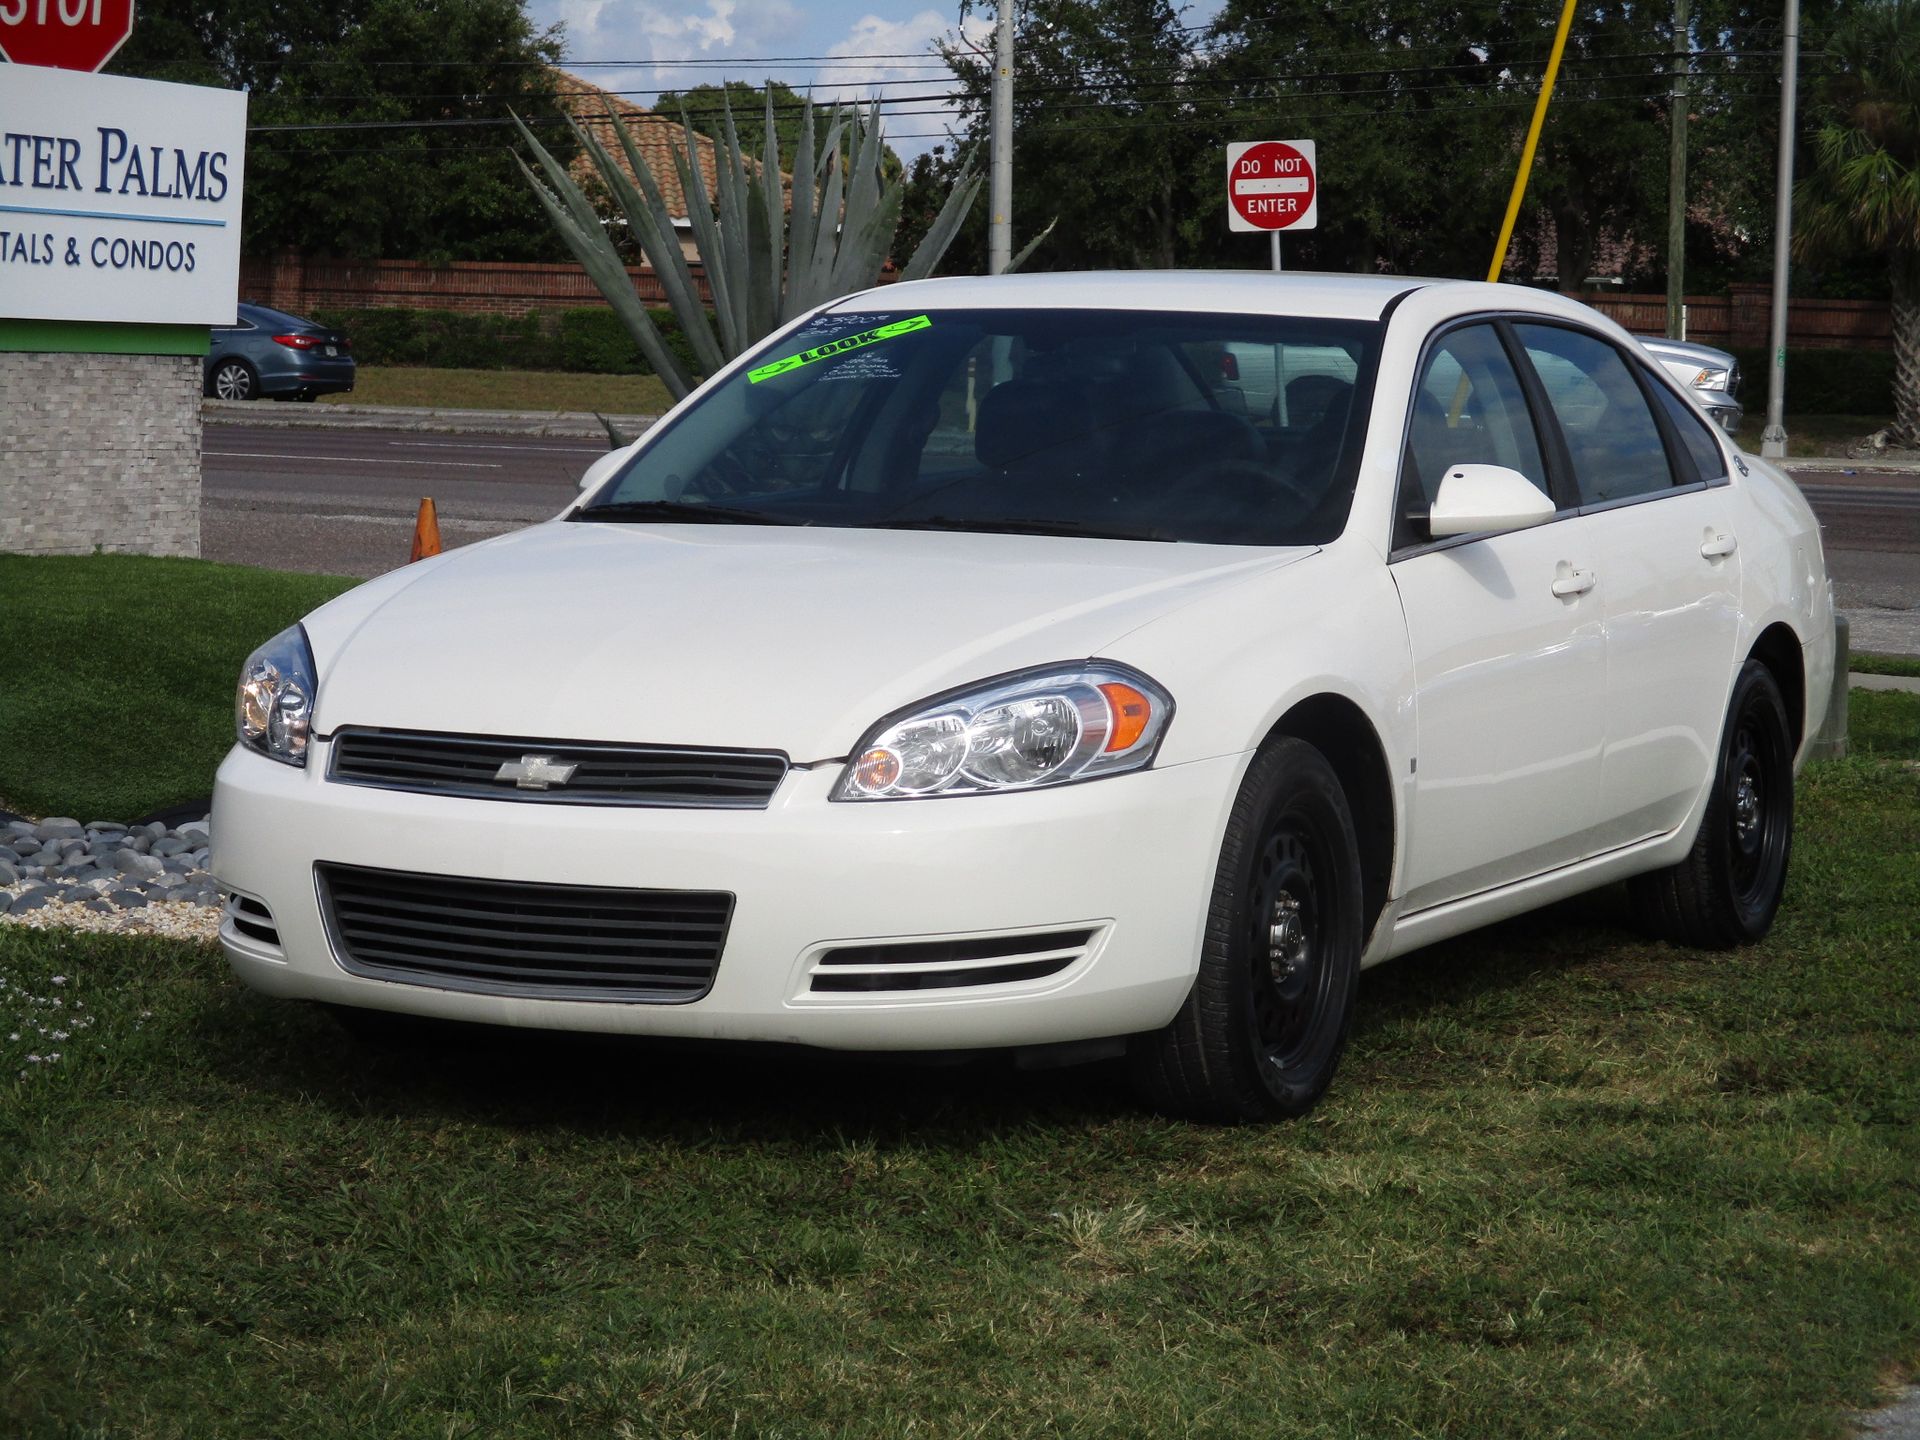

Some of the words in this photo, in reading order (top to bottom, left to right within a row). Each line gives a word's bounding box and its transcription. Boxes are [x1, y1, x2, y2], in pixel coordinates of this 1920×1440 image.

[0, 132, 83, 192] TER
[95, 126, 228, 202] PALMS
[1241, 160, 1261, 174] DO
[1274, 158, 1302, 173] NOT
[1247, 198, 1297, 214] ENTER
[64, 236, 81, 266] &
[91, 236, 196, 272] CONDOS
[800, 330, 881, 363] LOOK
